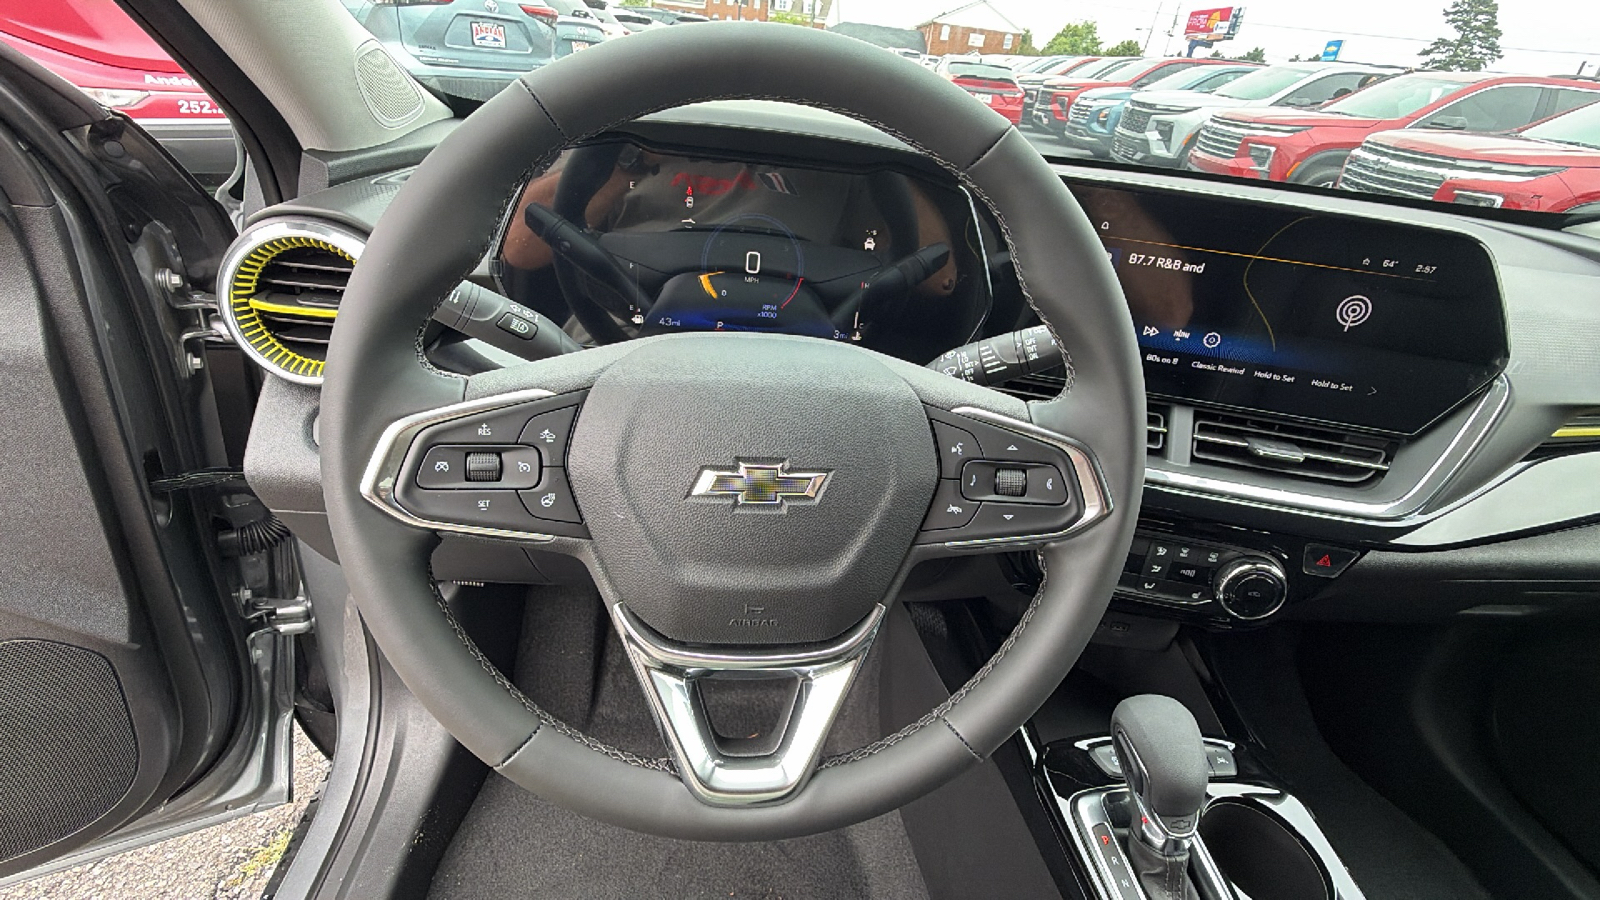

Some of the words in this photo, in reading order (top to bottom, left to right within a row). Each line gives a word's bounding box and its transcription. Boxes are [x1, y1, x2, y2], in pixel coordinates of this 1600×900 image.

[745, 251, 760, 274] 0
[1128, 252, 1156, 266] 87.7
[1156, 257, 1182, 271] R&B
[1182, 262, 1206, 274] and
[744, 276, 760, 284] MPH
[762, 304, 777, 312] RPM
[1191, 361, 1217, 371] Classic
[1217, 364, 1246, 375] Rewind
[1253, 370, 1272, 380] Hold
[1281, 374, 1296, 383] Set
[1311, 379, 1330, 388] Hold
[1339, 383, 1354, 392] Set
[477, 428, 491, 436] RES
